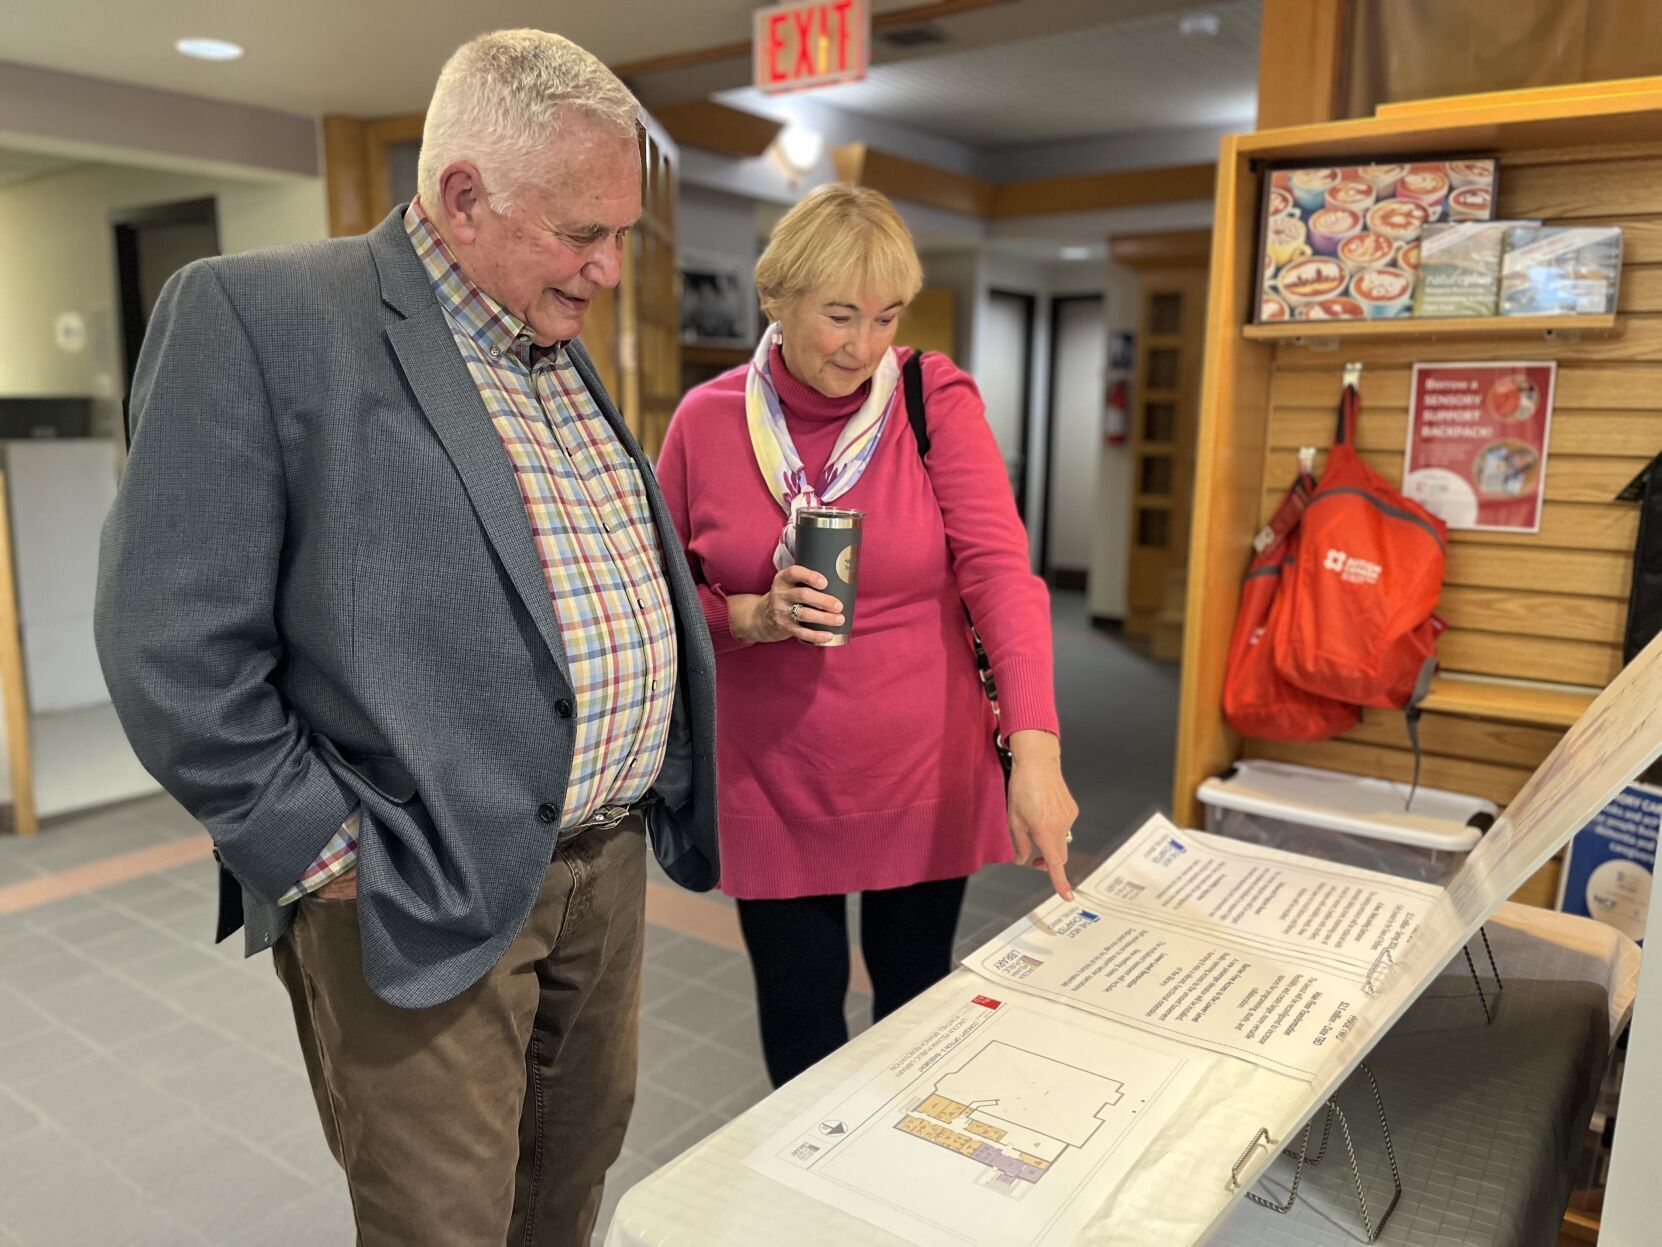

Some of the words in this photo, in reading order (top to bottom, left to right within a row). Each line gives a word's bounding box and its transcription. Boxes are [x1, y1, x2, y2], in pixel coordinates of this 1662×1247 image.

[767, 0, 852, 82] EXIT
[1424, 394, 1483, 406] SENSORY
[1422, 410, 1482, 422] SUPPORT
[986, 949, 1024, 970] LIBRARY
[1282, 1008, 1310, 1037] Transformation
[1317, 1024, 1333, 1037] Date
[1311, 1034, 1326, 1046] TBD
